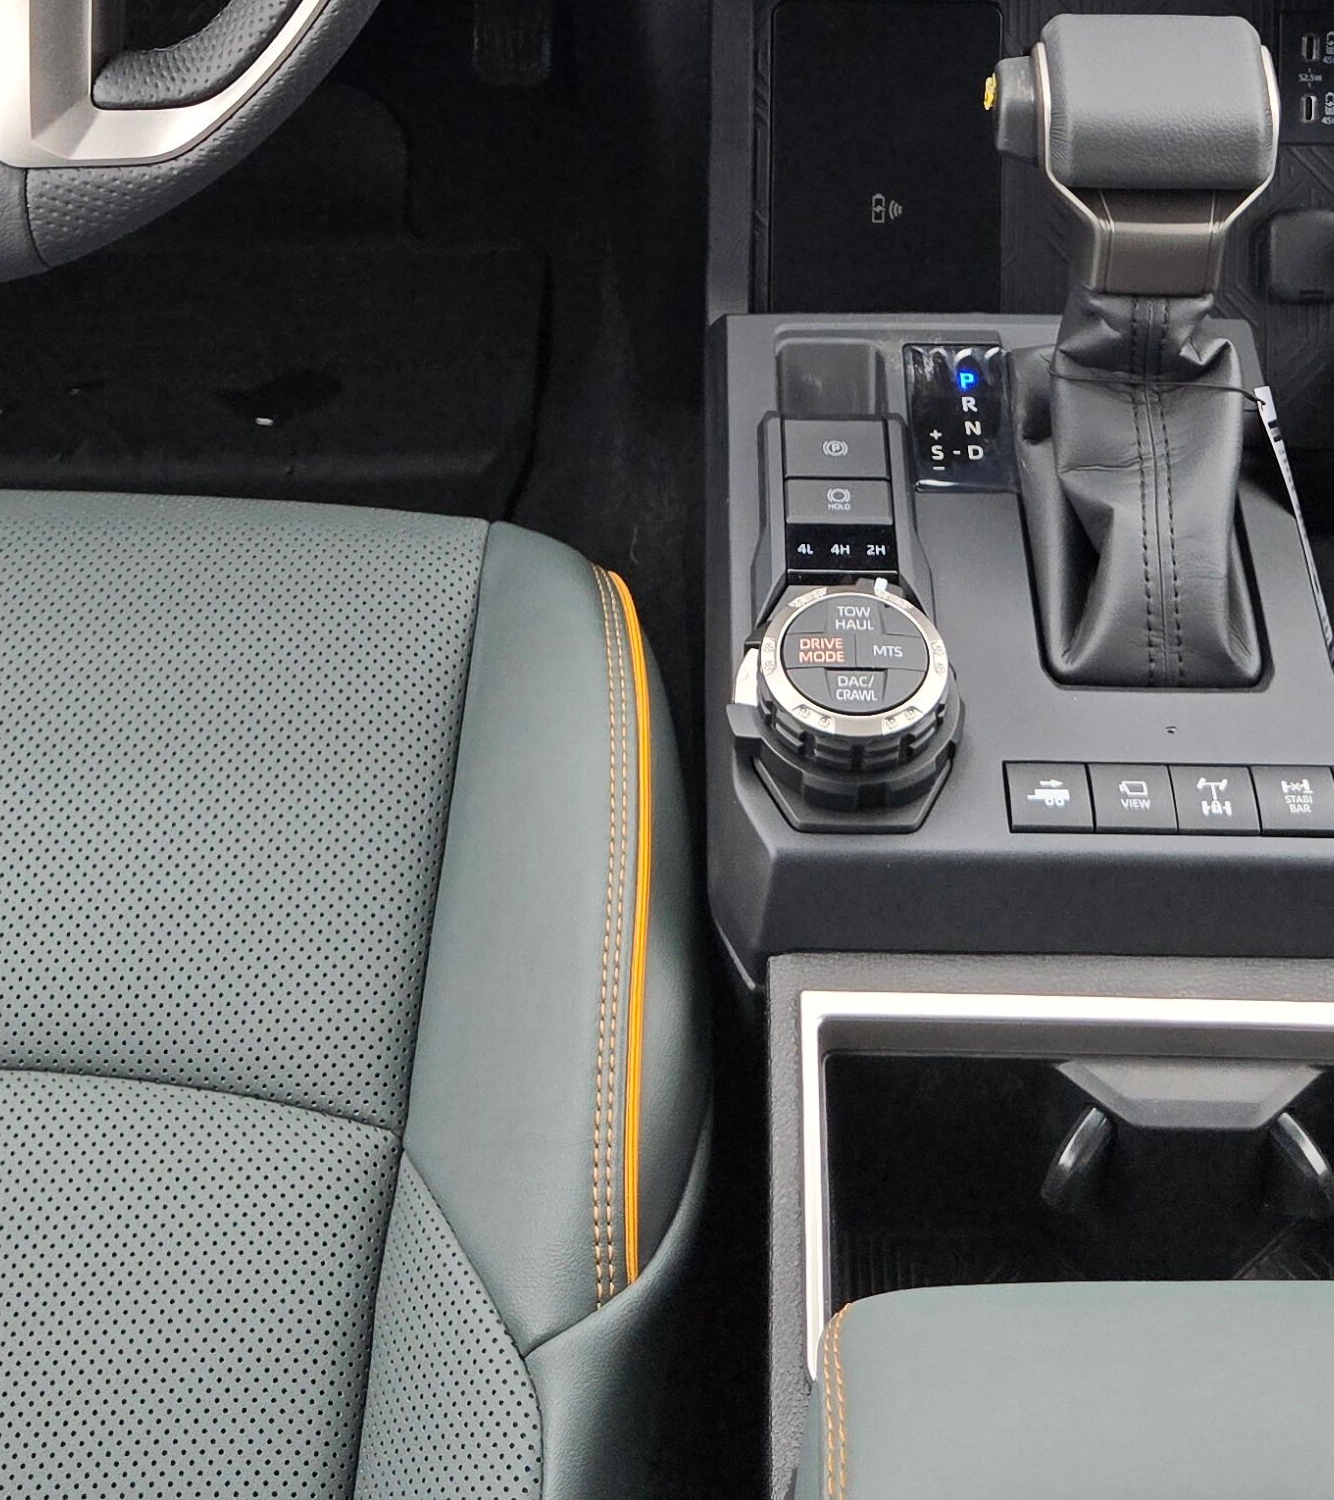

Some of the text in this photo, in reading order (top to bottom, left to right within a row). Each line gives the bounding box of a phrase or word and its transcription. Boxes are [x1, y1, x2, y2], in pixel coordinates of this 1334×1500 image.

[960, 373, 974, 388] P
[962, 396, 978, 412] R
[964, 420, 981, 436] N
[931, 445, 984, 460] S D
[828, 503, 851, 511] HOLD
[797, 544, 814, 555] 4L
[830, 544, 851, 555] 4H
[866, 544, 886, 555] 2H
[837, 606, 871, 617] TOW
[835, 619, 874, 631] HAUL
[799, 637, 844, 650] DRIVE
[799, 650, 846, 663] MODE
[873, 645, 903, 657] MTS
[838, 675, 874, 687] DAC/
[836, 689, 878, 701] CRAWL
[1120, 798, 1151, 809] VIEW
[1284, 794, 1313, 804] STABI
[1289, 803, 1312, 813] BAR
